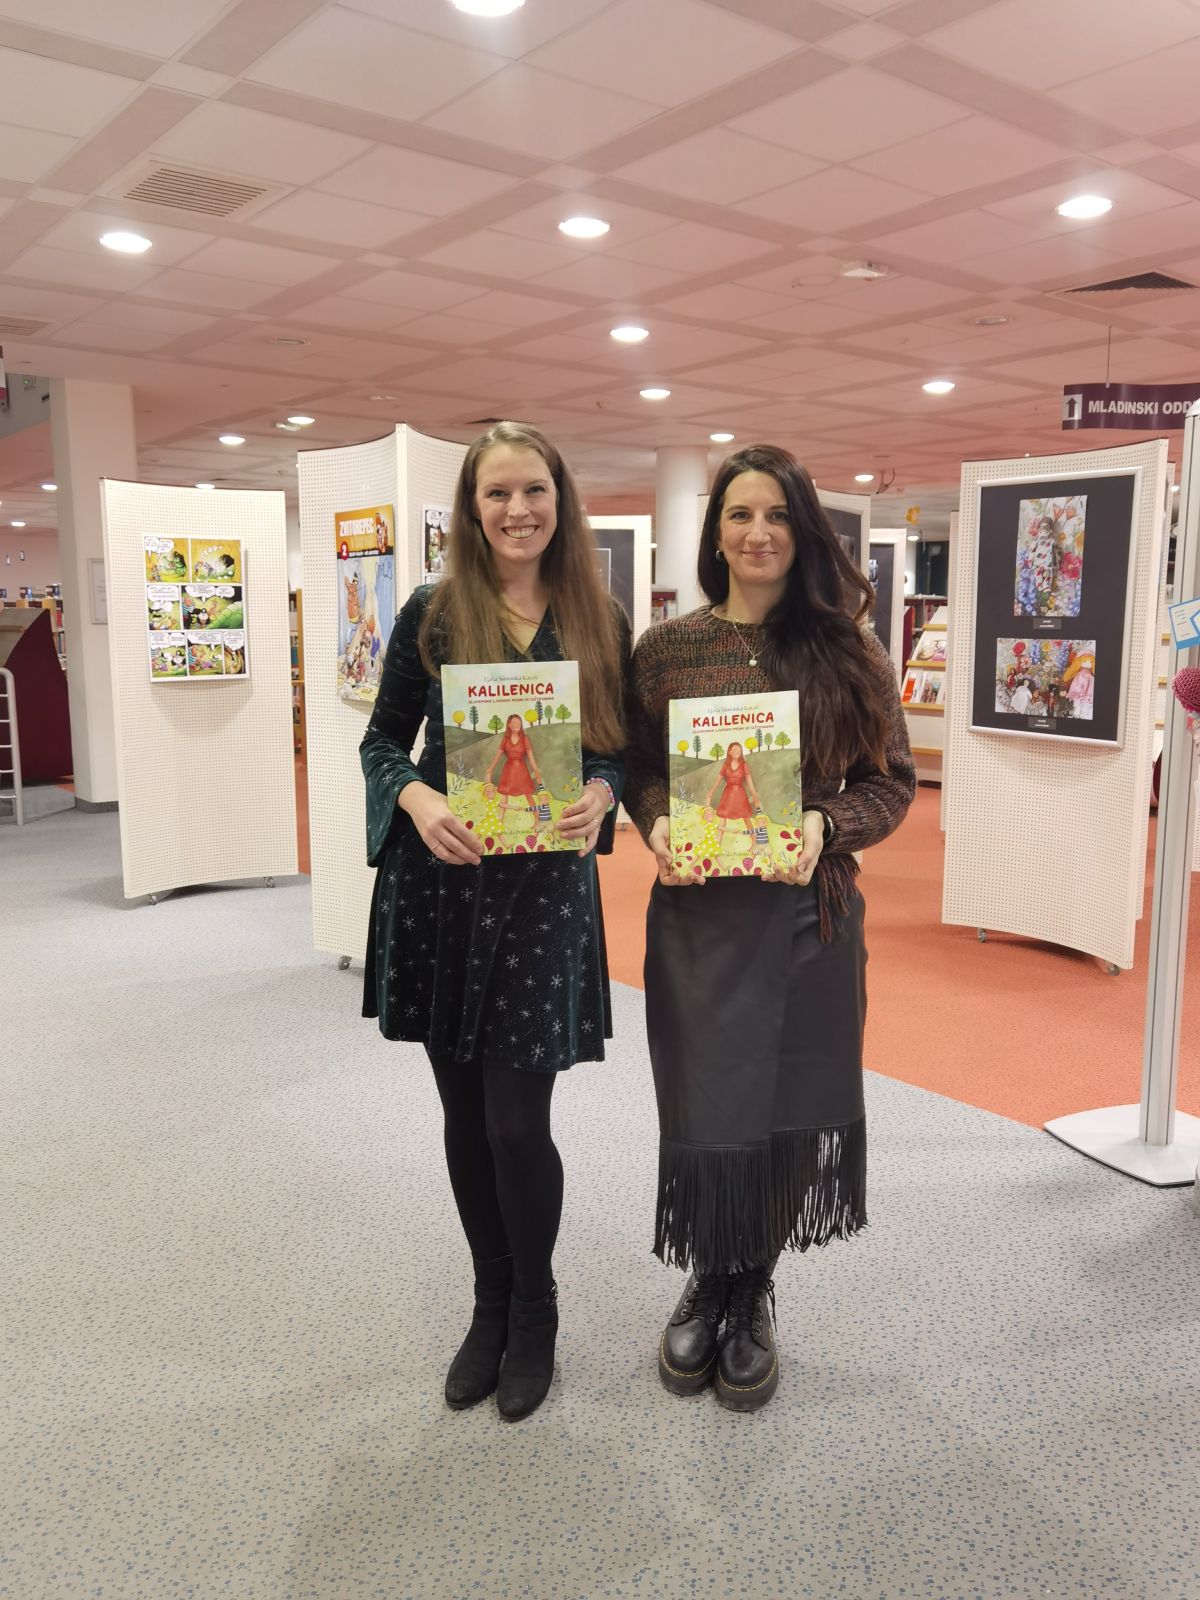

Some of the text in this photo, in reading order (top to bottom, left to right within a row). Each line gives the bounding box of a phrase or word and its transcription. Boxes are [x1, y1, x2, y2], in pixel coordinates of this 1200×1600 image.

[1088, 400, 1196, 415] MLADINSKI ODD
[341, 544, 348, 556] 2
[468, 683, 554, 698] KALILENICA
[692, 712, 774, 728] KALILENICA
